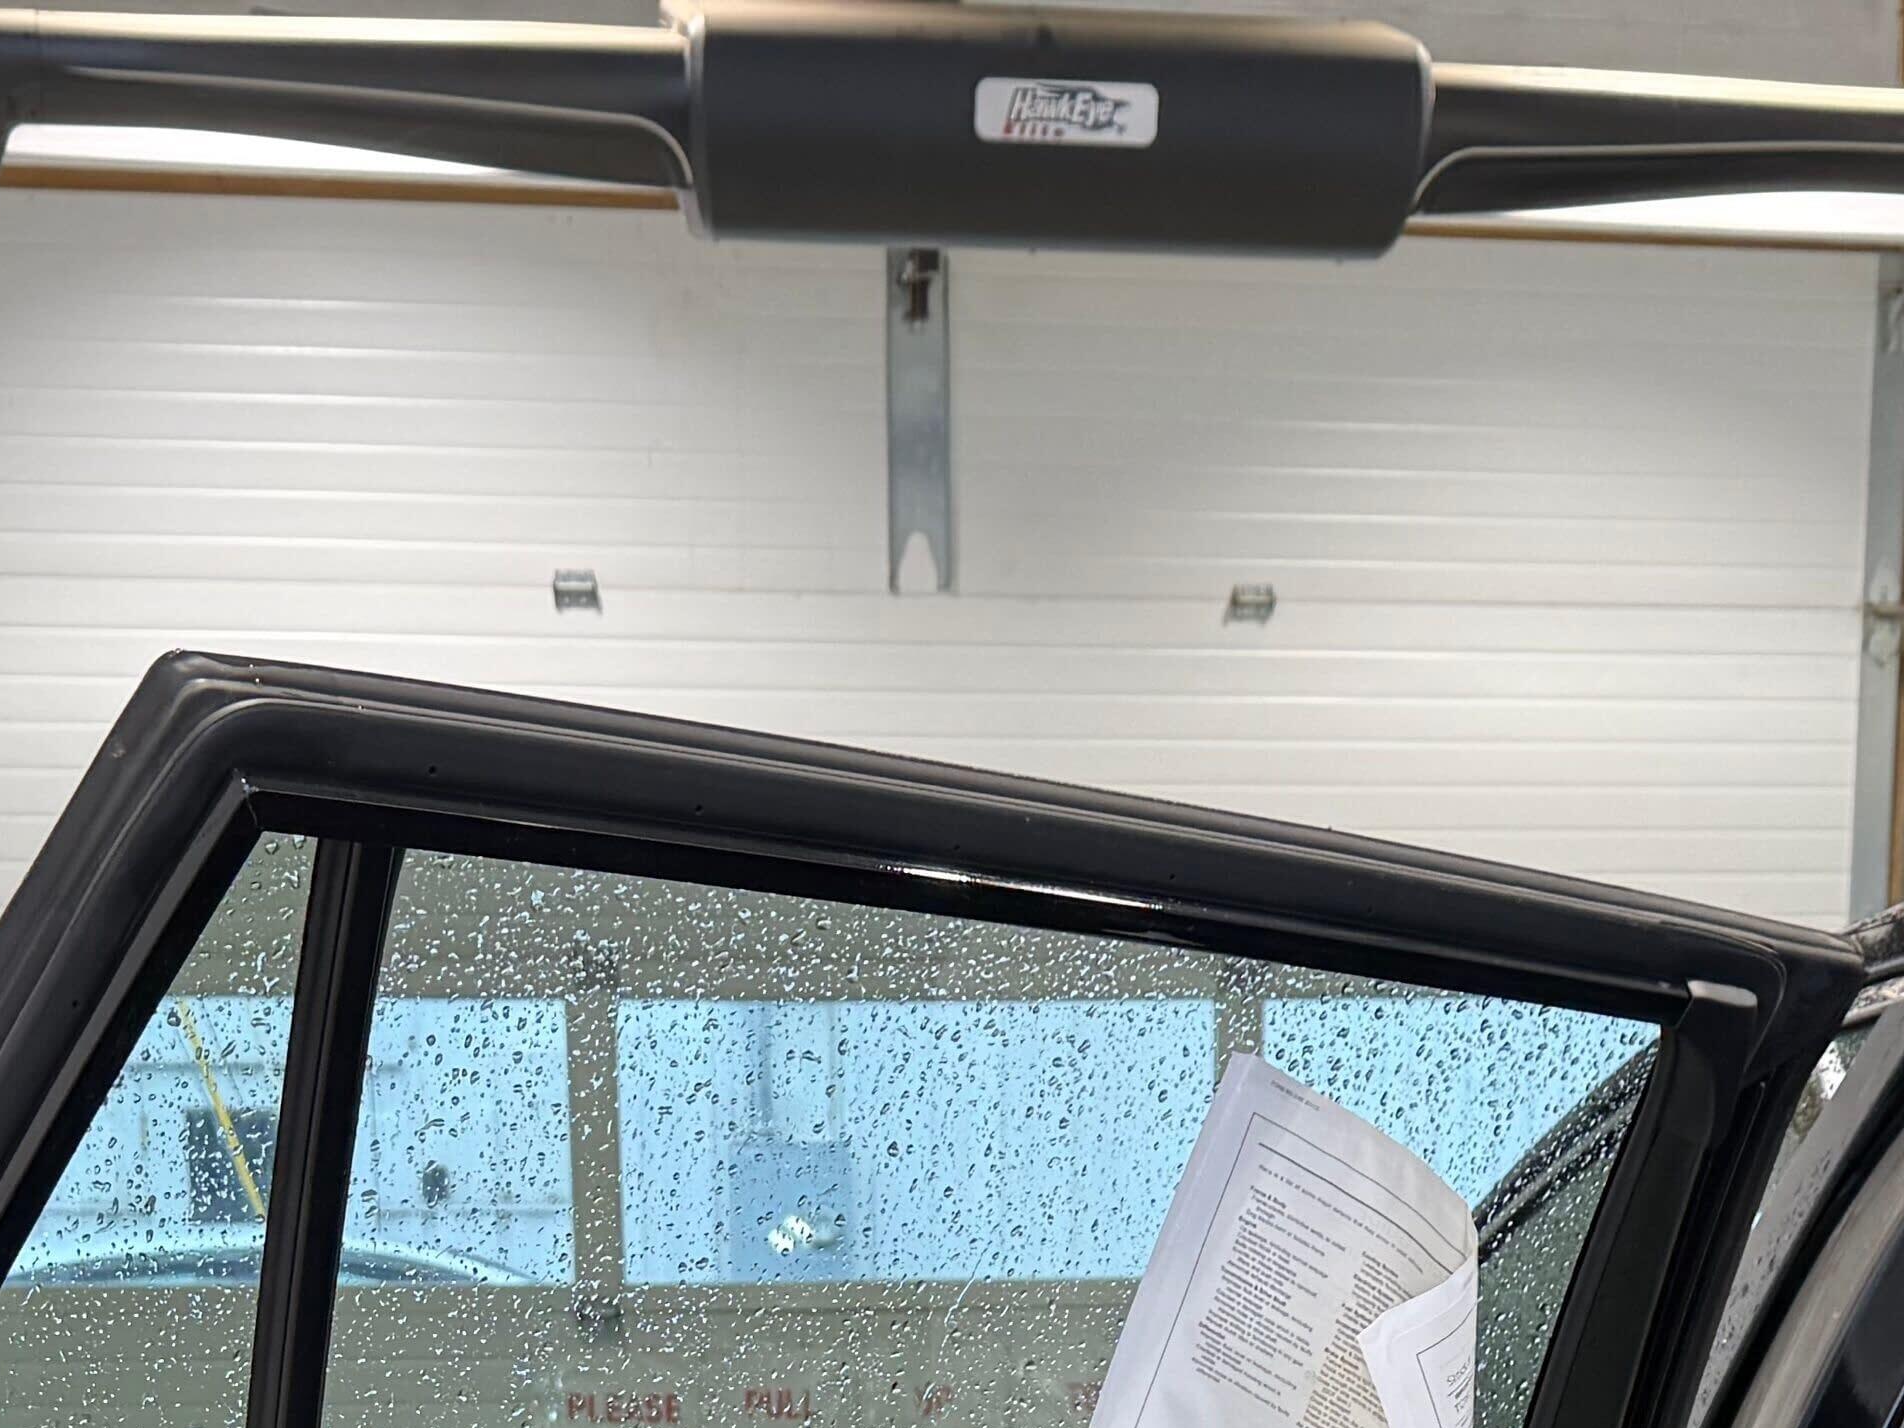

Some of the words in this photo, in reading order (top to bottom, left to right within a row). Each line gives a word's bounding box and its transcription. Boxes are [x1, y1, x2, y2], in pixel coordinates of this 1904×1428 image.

[1009, 88, 1115, 128] HawkEye
[567, 1391, 681, 1424] PLEASE
[743, 1389, 816, 1420] PULL
